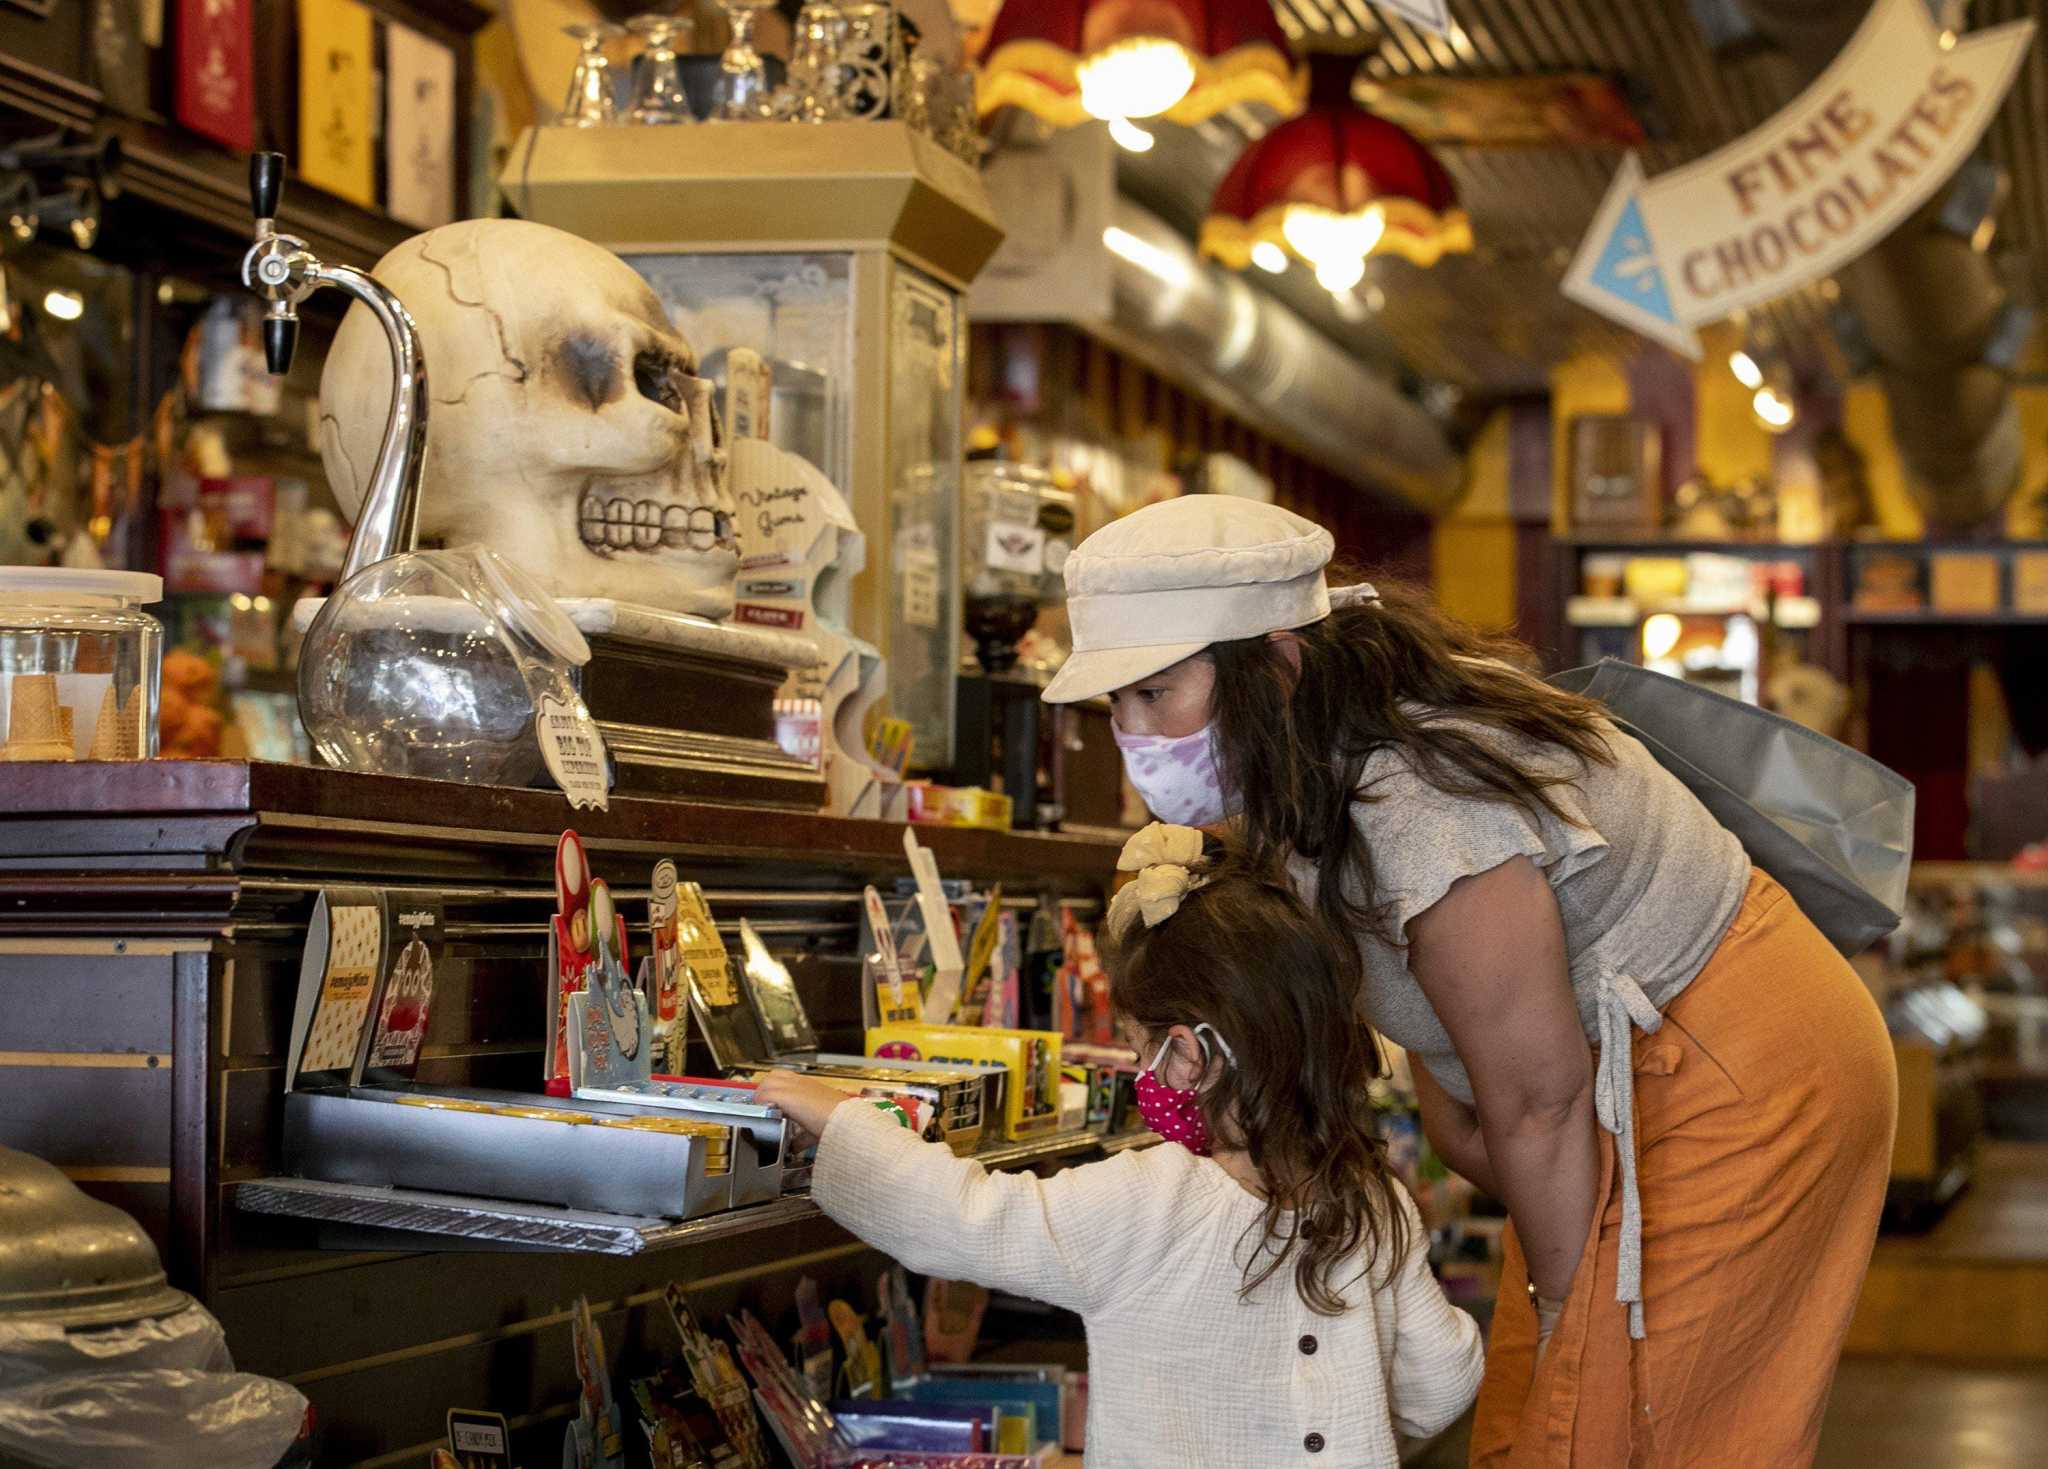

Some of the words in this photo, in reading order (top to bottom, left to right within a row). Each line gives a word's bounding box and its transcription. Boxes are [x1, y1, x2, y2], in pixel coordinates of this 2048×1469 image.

[1680, 65, 1977, 298] CHOCOLATES
[1726, 88, 1879, 216] FINE
[739, 487, 807, 508] Vintage
